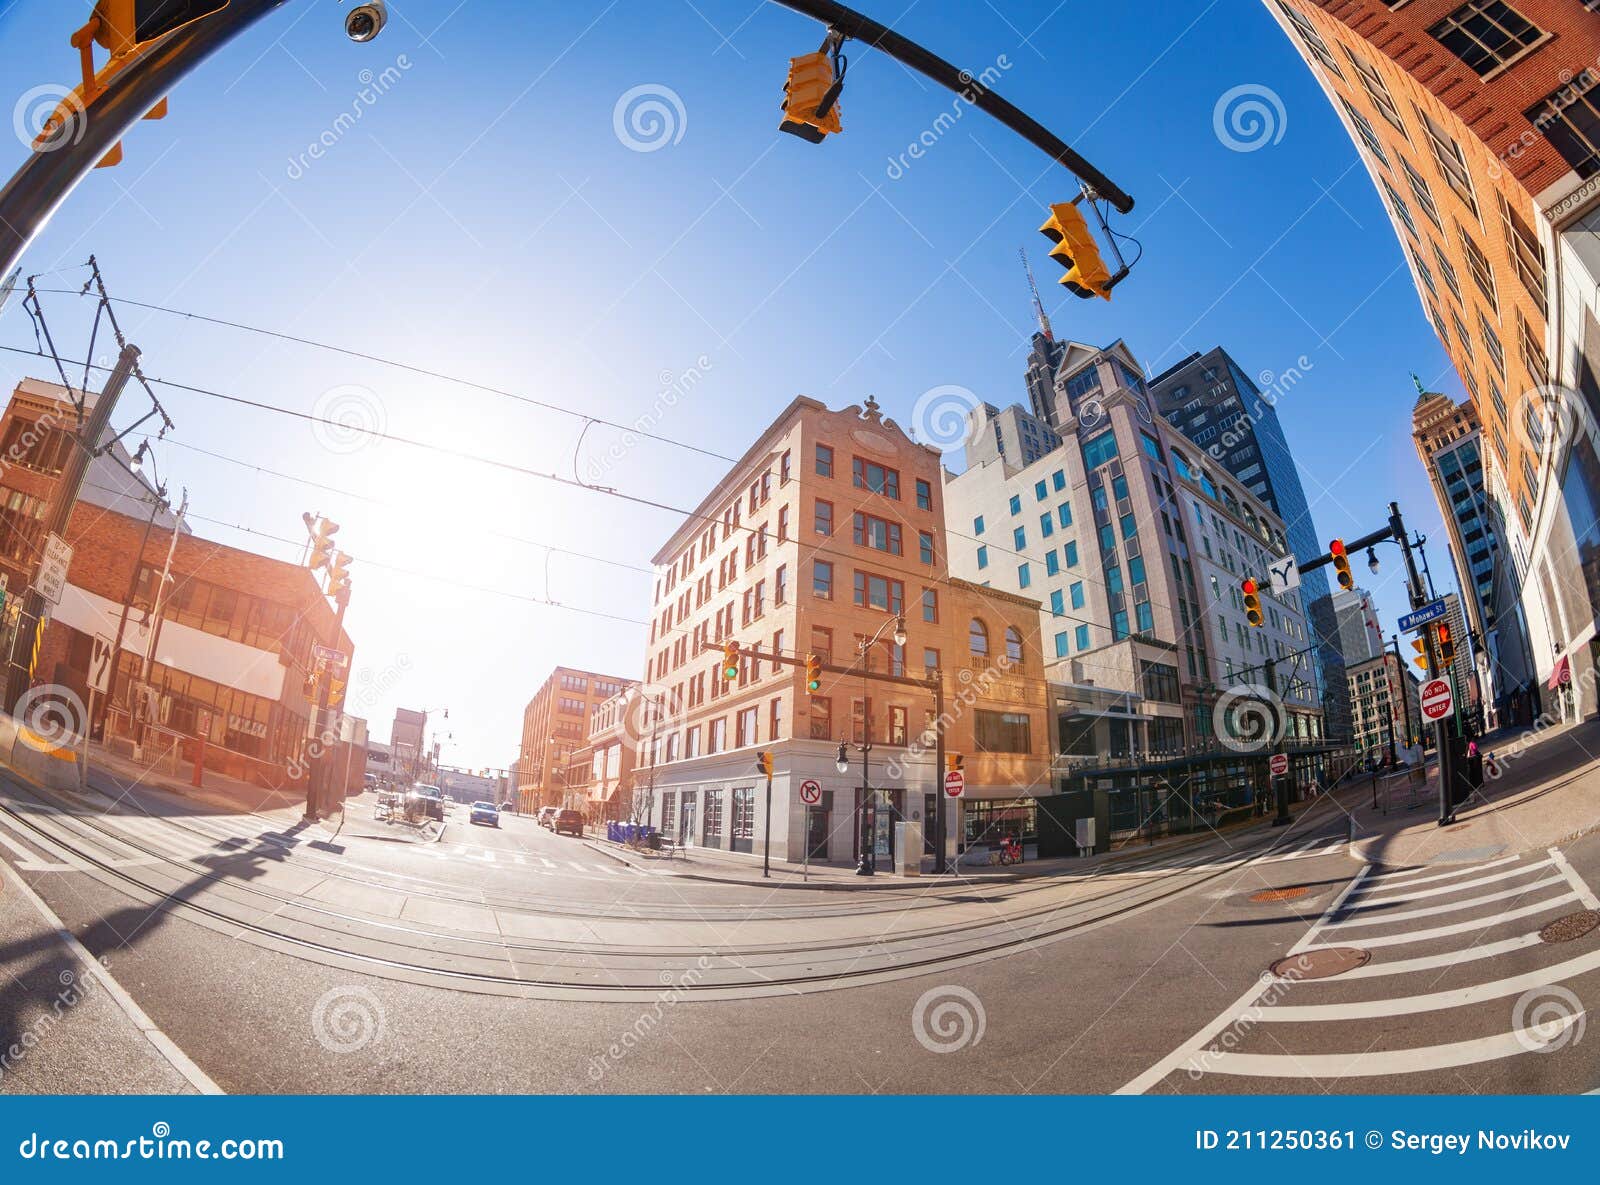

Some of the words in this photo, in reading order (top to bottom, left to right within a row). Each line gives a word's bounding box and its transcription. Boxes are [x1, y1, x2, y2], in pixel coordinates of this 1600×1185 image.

[1408, 610, 1434, 625] Mohawk
[1435, 604, 1442, 613] St
[1424, 689, 1433, 697] DO
[1434, 683, 1446, 694] NOT
[1428, 702, 1447, 715] ENTER
